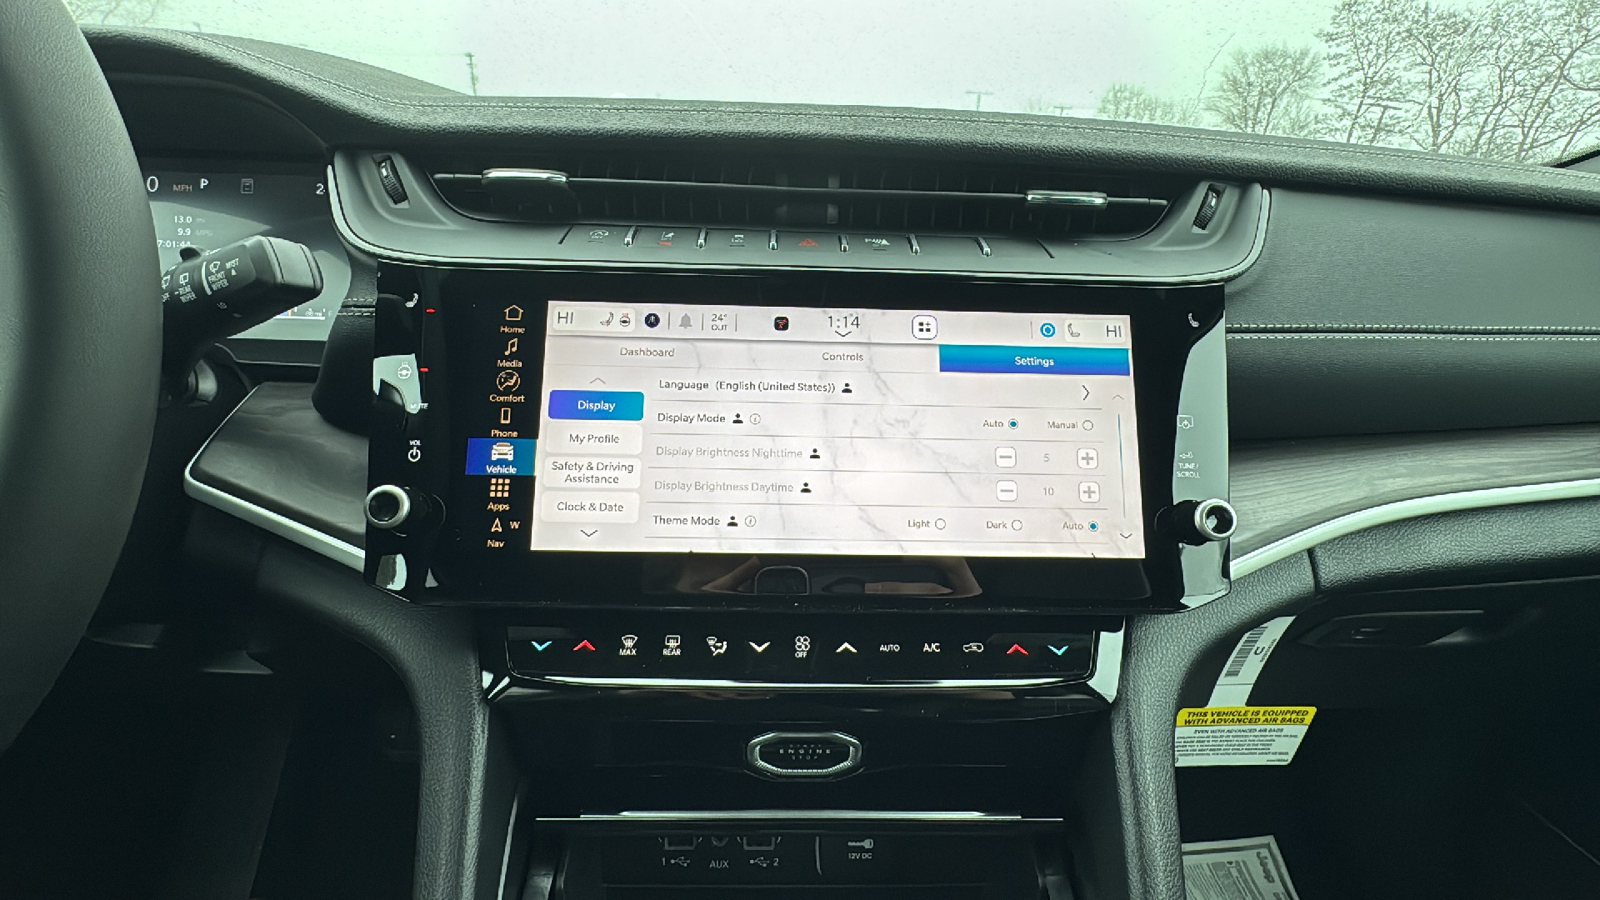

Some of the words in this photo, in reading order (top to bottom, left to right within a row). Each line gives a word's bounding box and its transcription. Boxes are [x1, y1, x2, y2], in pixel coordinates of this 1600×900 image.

[172, 184, 192, 192] MPH
[200, 178, 208, 189] P
[174, 215, 192, 224] 13.0
[177, 228, 191, 236] 9.9
[225, 258, 240, 269] MIST
[208, 270, 226, 284] FRONT
[211, 278, 229, 290] WIPER
[178, 284, 192, 296] REAR
[557, 312, 574, 324] HI
[711, 313, 728, 322] 24°
[828, 316, 860, 328] 1:14
[500, 326, 526, 334] Home
[1106, 325, 1122, 338] HI
[620, 347, 675, 358] Dashboard
[822, 352, 864, 362] Controls
[496, 360, 523, 368] Media
[1014, 356, 1054, 368] Settings
[658, 380, 710, 390] Language
[715, 380, 756, 392] (English
[758, 382, 796, 392] (United
[797, 382, 836, 393] States))
[489, 394, 526, 402] Comfort
[577, 400, 616, 412] Display
[657, 412, 694, 424] Display
[696, 414, 726, 423] Mode
[982, 419, 1004, 428] Auto
[1047, 420, 1078, 430] Manual
[491, 430, 518, 438] Phone
[569, 434, 586, 445] My
[587, 434, 620, 444] Profile
[656, 446, 694, 458] Display
[696, 448, 750, 458] Brightness
[752, 448, 803, 460] Nighttime
[1043, 454, 1050, 462] 5
[486, 465, 517, 474] Vehicle
[551, 461, 584, 473] Safety
[586, 462, 594, 472] &
[596, 462, 634, 474] Driving
[564, 474, 620, 484] Assistance
[1176, 471, 1201, 479] SCROLL
[654, 480, 692, 492] Display
[694, 481, 749, 492] Brightness
[750, 482, 794, 493] Daytime
[1042, 487, 1054, 496] 10
[486, 502, 510, 512] Apps
[556, 502, 586, 512] Clock
[588, 502, 597, 512] &
[599, 502, 624, 512] Date
[653, 514, 688, 525] Theme
[690, 516, 721, 526] Mode
[908, 519, 930, 529] Light
[986, 520, 1008, 530] Dark
[510, 522, 520, 530] W
[1062, 522, 1084, 530] Auto
[486, 540, 505, 548] Nav
[880, 644, 900, 652] AUTO
[922, 643, 940, 652] A/C
[661, 858, 666, 866] 1
[709, 860, 730, 868] AUX
